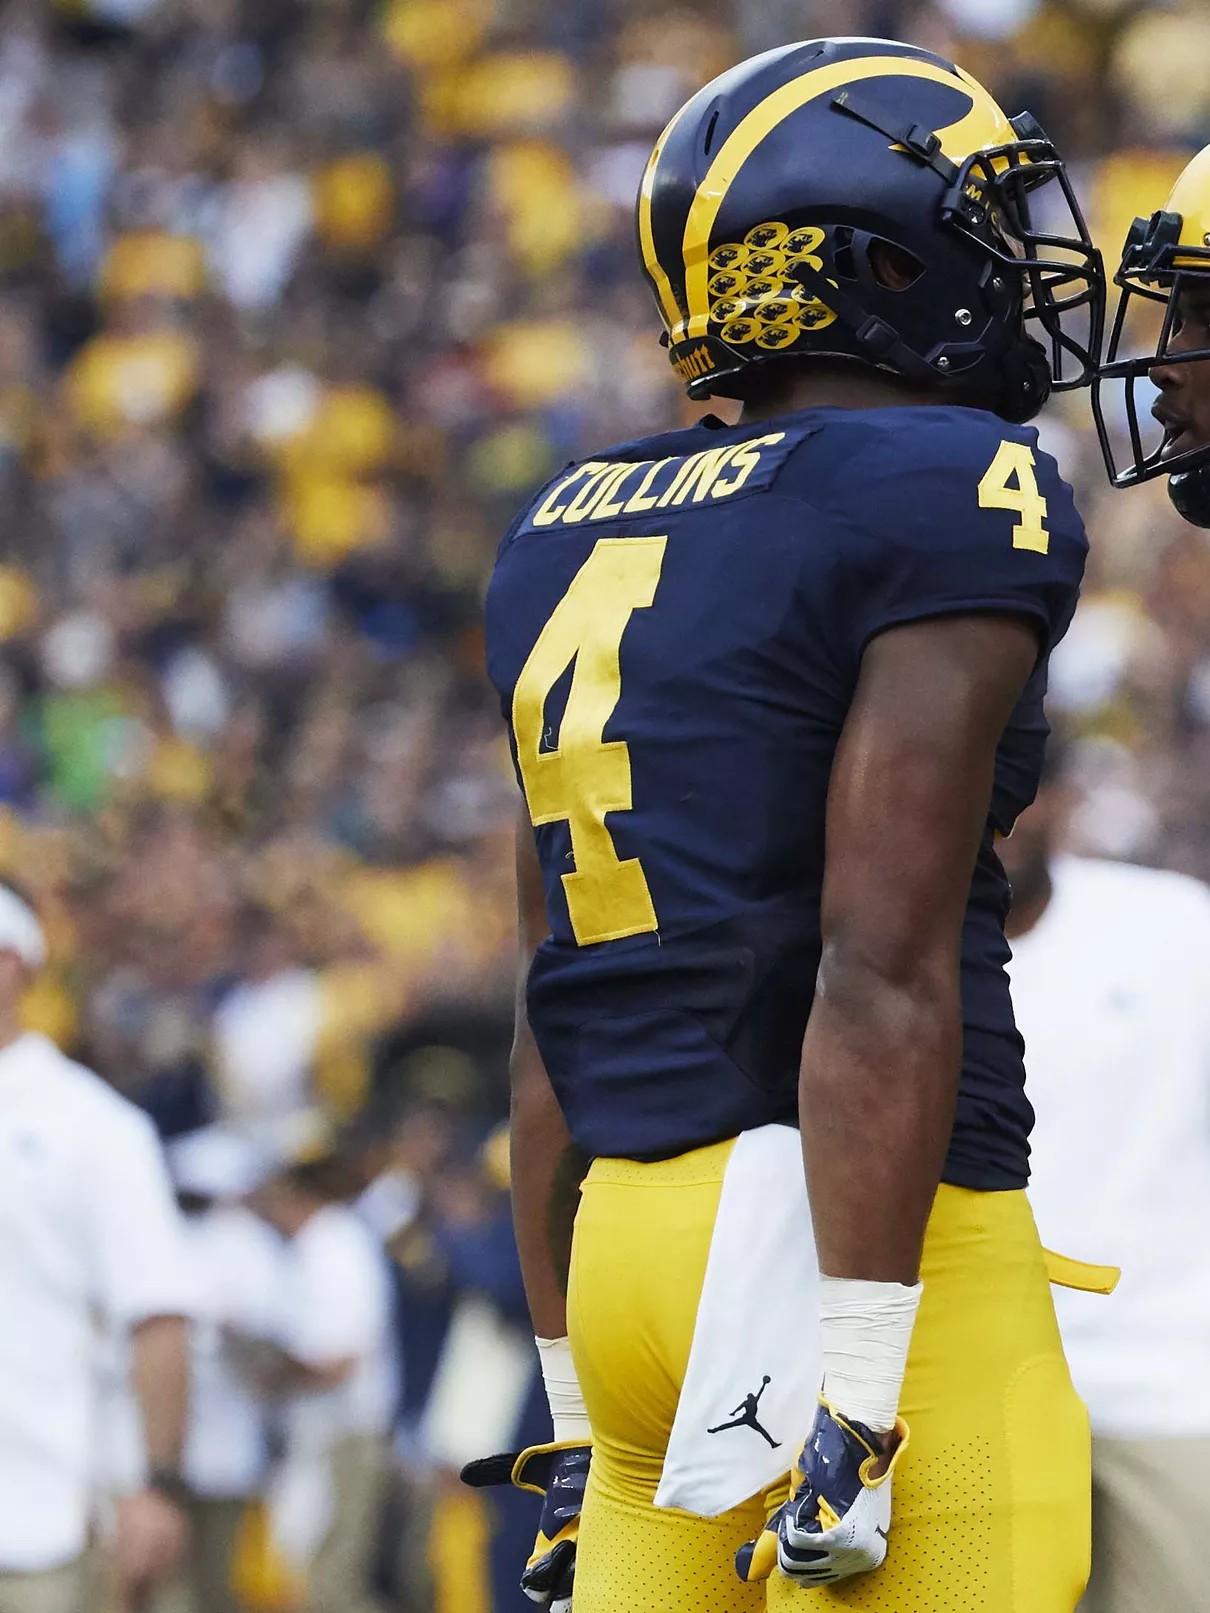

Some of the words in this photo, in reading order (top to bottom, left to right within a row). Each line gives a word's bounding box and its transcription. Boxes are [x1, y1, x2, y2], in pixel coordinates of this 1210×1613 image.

[533, 432, 785, 527] COLLINS
[978, 440, 1050, 555] 4
[512, 535, 668, 947] 4
